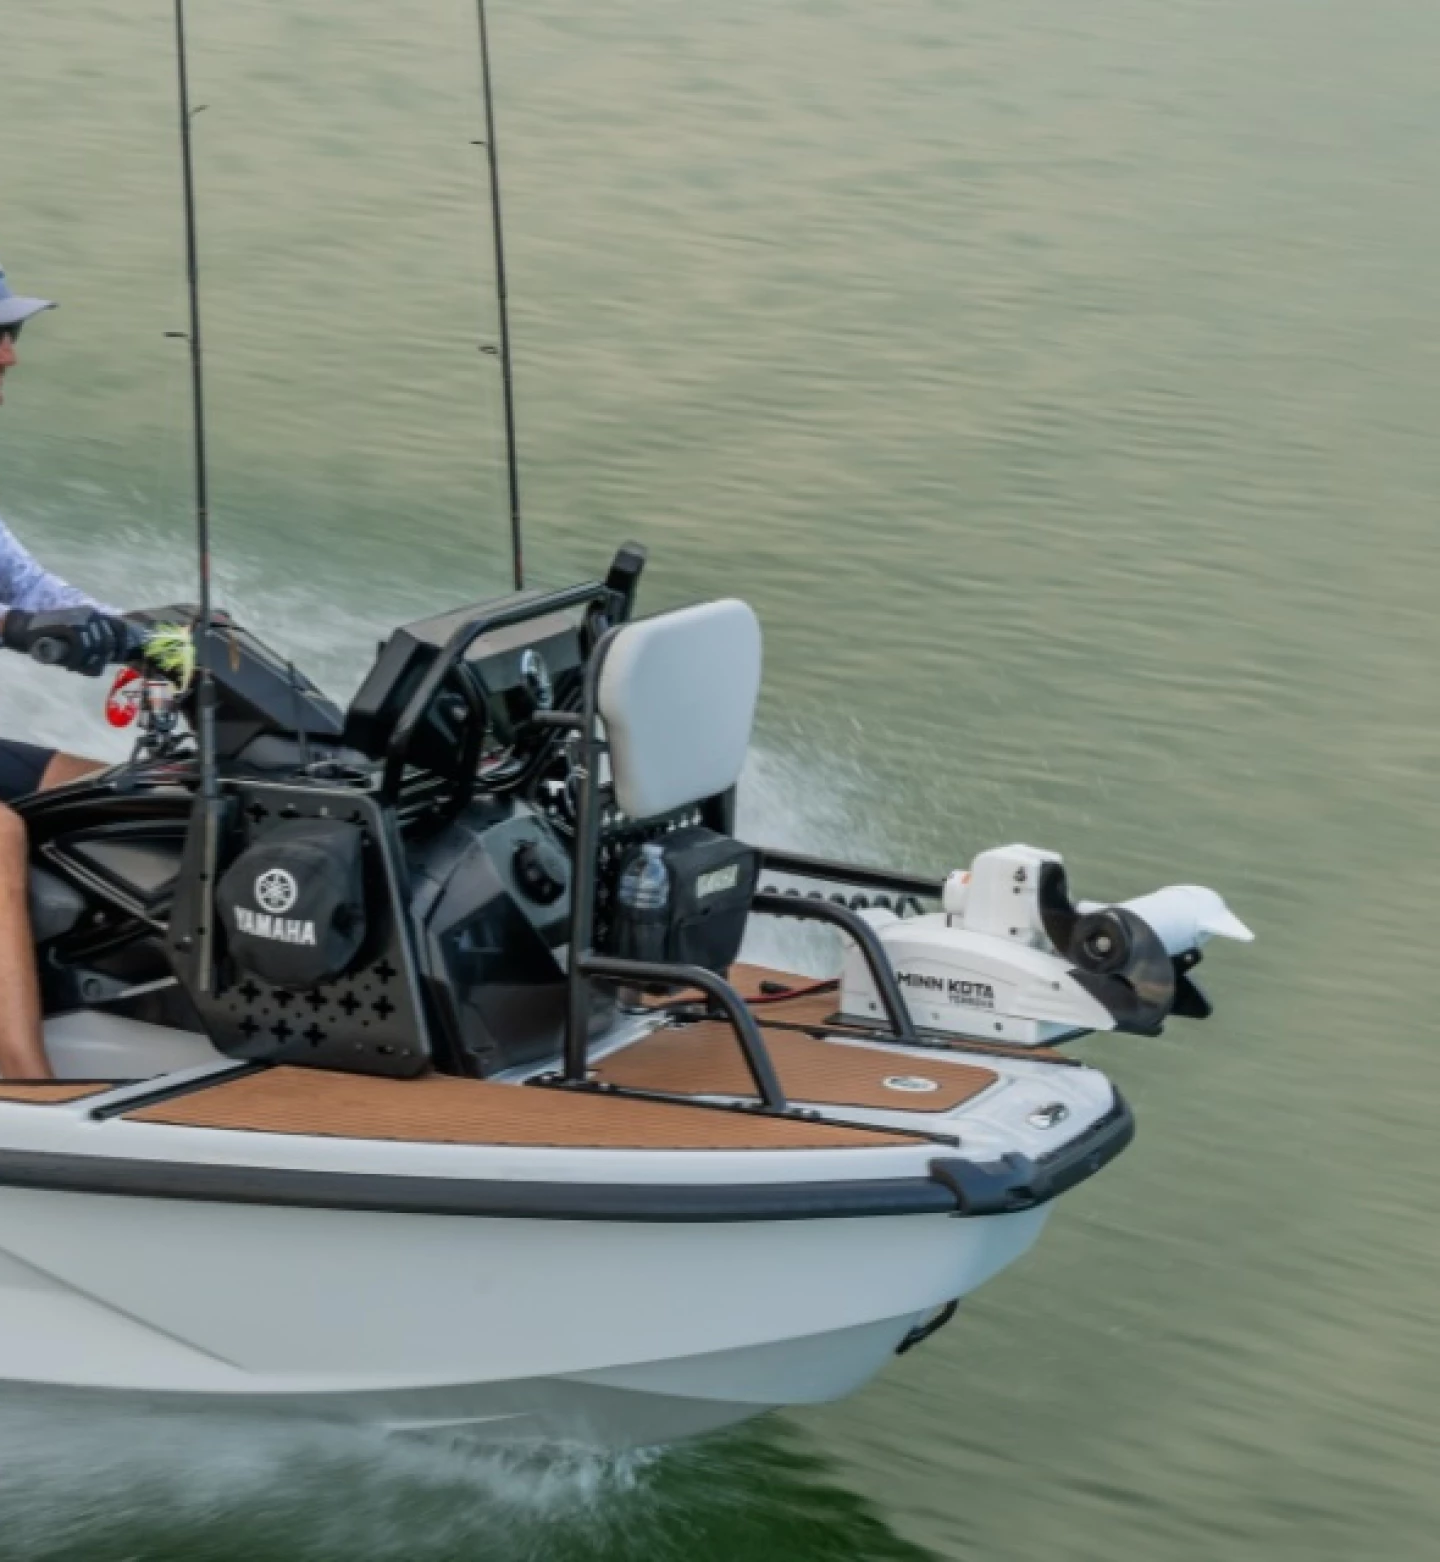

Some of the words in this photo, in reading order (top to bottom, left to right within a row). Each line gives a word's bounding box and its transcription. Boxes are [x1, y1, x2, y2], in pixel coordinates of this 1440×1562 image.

[233, 906, 316, 945] YAMAHA
[897, 971, 942, 991] MINN
[948, 979, 994, 998] KOTA
